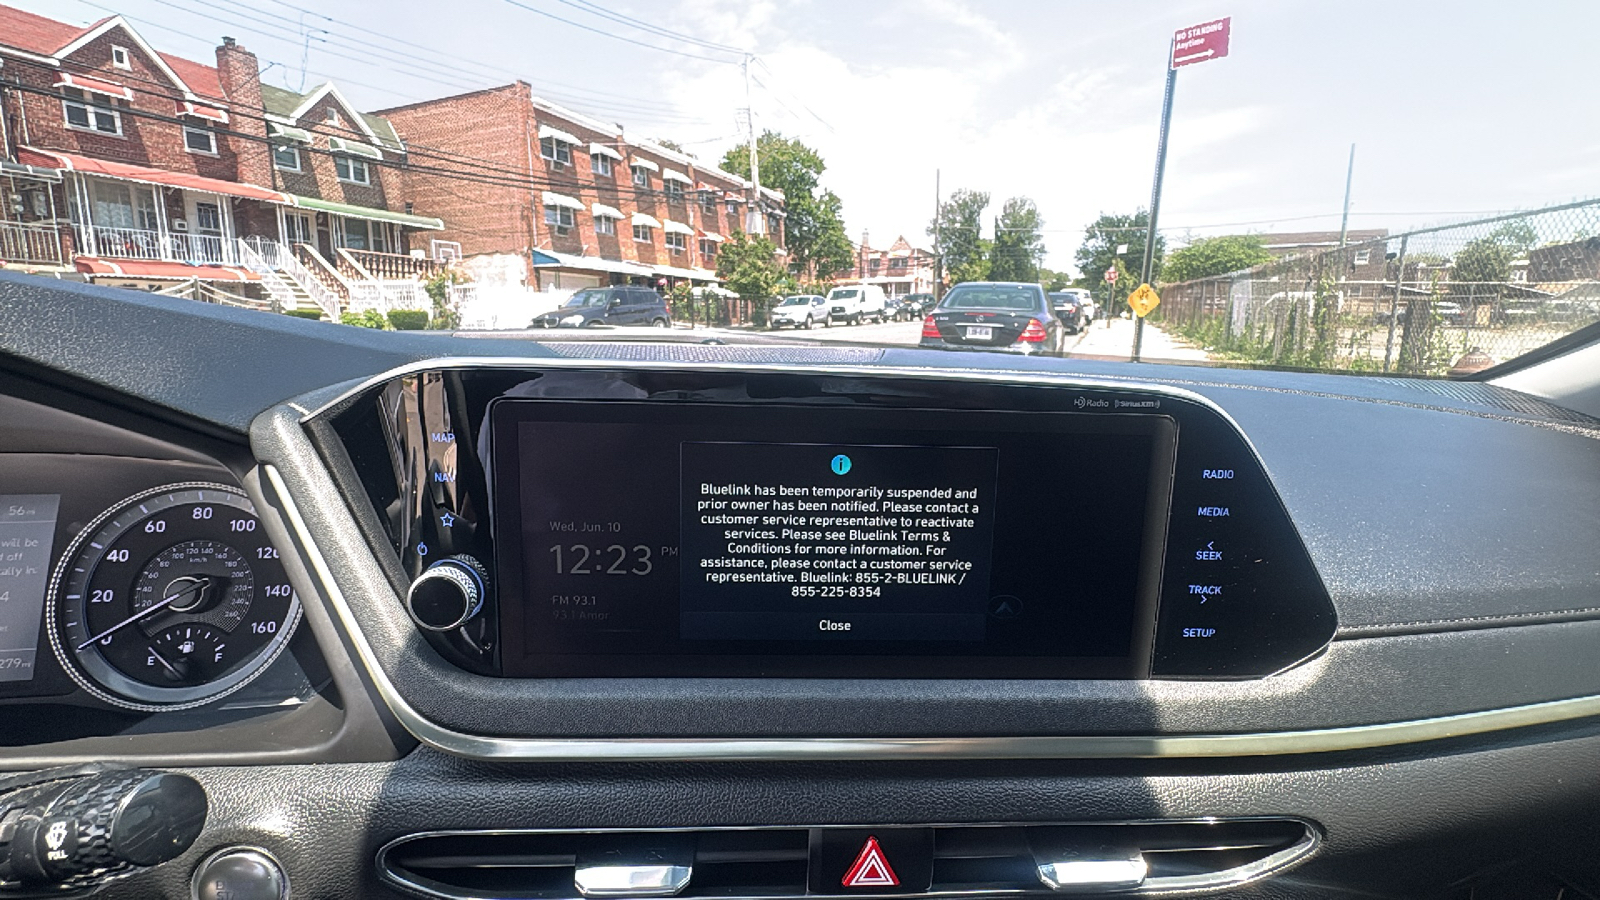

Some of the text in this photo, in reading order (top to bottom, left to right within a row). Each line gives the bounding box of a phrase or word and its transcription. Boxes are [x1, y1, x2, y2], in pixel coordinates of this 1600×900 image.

[1176, 22, 1223, 41] NO STANDING
[1176, 38, 1205, 50] Anytime
[1087, 400, 1109, 408] Radio
[432, 433, 455, 443] MAP
[1202, 469, 1235, 480] RADIO
[701, 483, 977, 500] Bluelink has been temporarily suspended and
[9, 505, 26, 516] 56
[698, 499, 979, 513] prior owner has been notified. Please contact a
[1197, 506, 1230, 518] MEDIA
[192, 507, 213, 520] 80
[145, 519, 166, 533] 60
[229, 518, 256, 532] 100
[701, 514, 974, 527] customer service representative to reactivate
[580, 521, 605, 533] Jun.
[609, 521, 621, 533] 10
[725, 529, 950, 542] services. Please see Bluelink Terms &
[1, 538, 39, 547] will be
[728, 543, 947, 555] Conditions for more information. For
[106, 549, 129, 562] 40
[549, 544, 679, 576] 12:23 PM
[1195, 551, 1222, 561] SEEK
[700, 557, 972, 570] assistance, please contact a customer service
[706, 572, 966, 585] representative. Bluelink: 855-2-BLUELINK /
[265, 584, 290, 597] 140
[792, 586, 880, 597] 855-225-8354
[1189, 584, 1222, 595] TRACK
[91, 589, 114, 603] 20
[552, 595, 597, 606] FM 93.1
[552, 610, 610, 621] 93.1 Amor
[251, 621, 277, 635] 160
[819, 620, 851, 630] Close
[1183, 628, 1216, 638] SETUP
[147, 656, 155, 667] E
[215, 652, 223, 663] F
